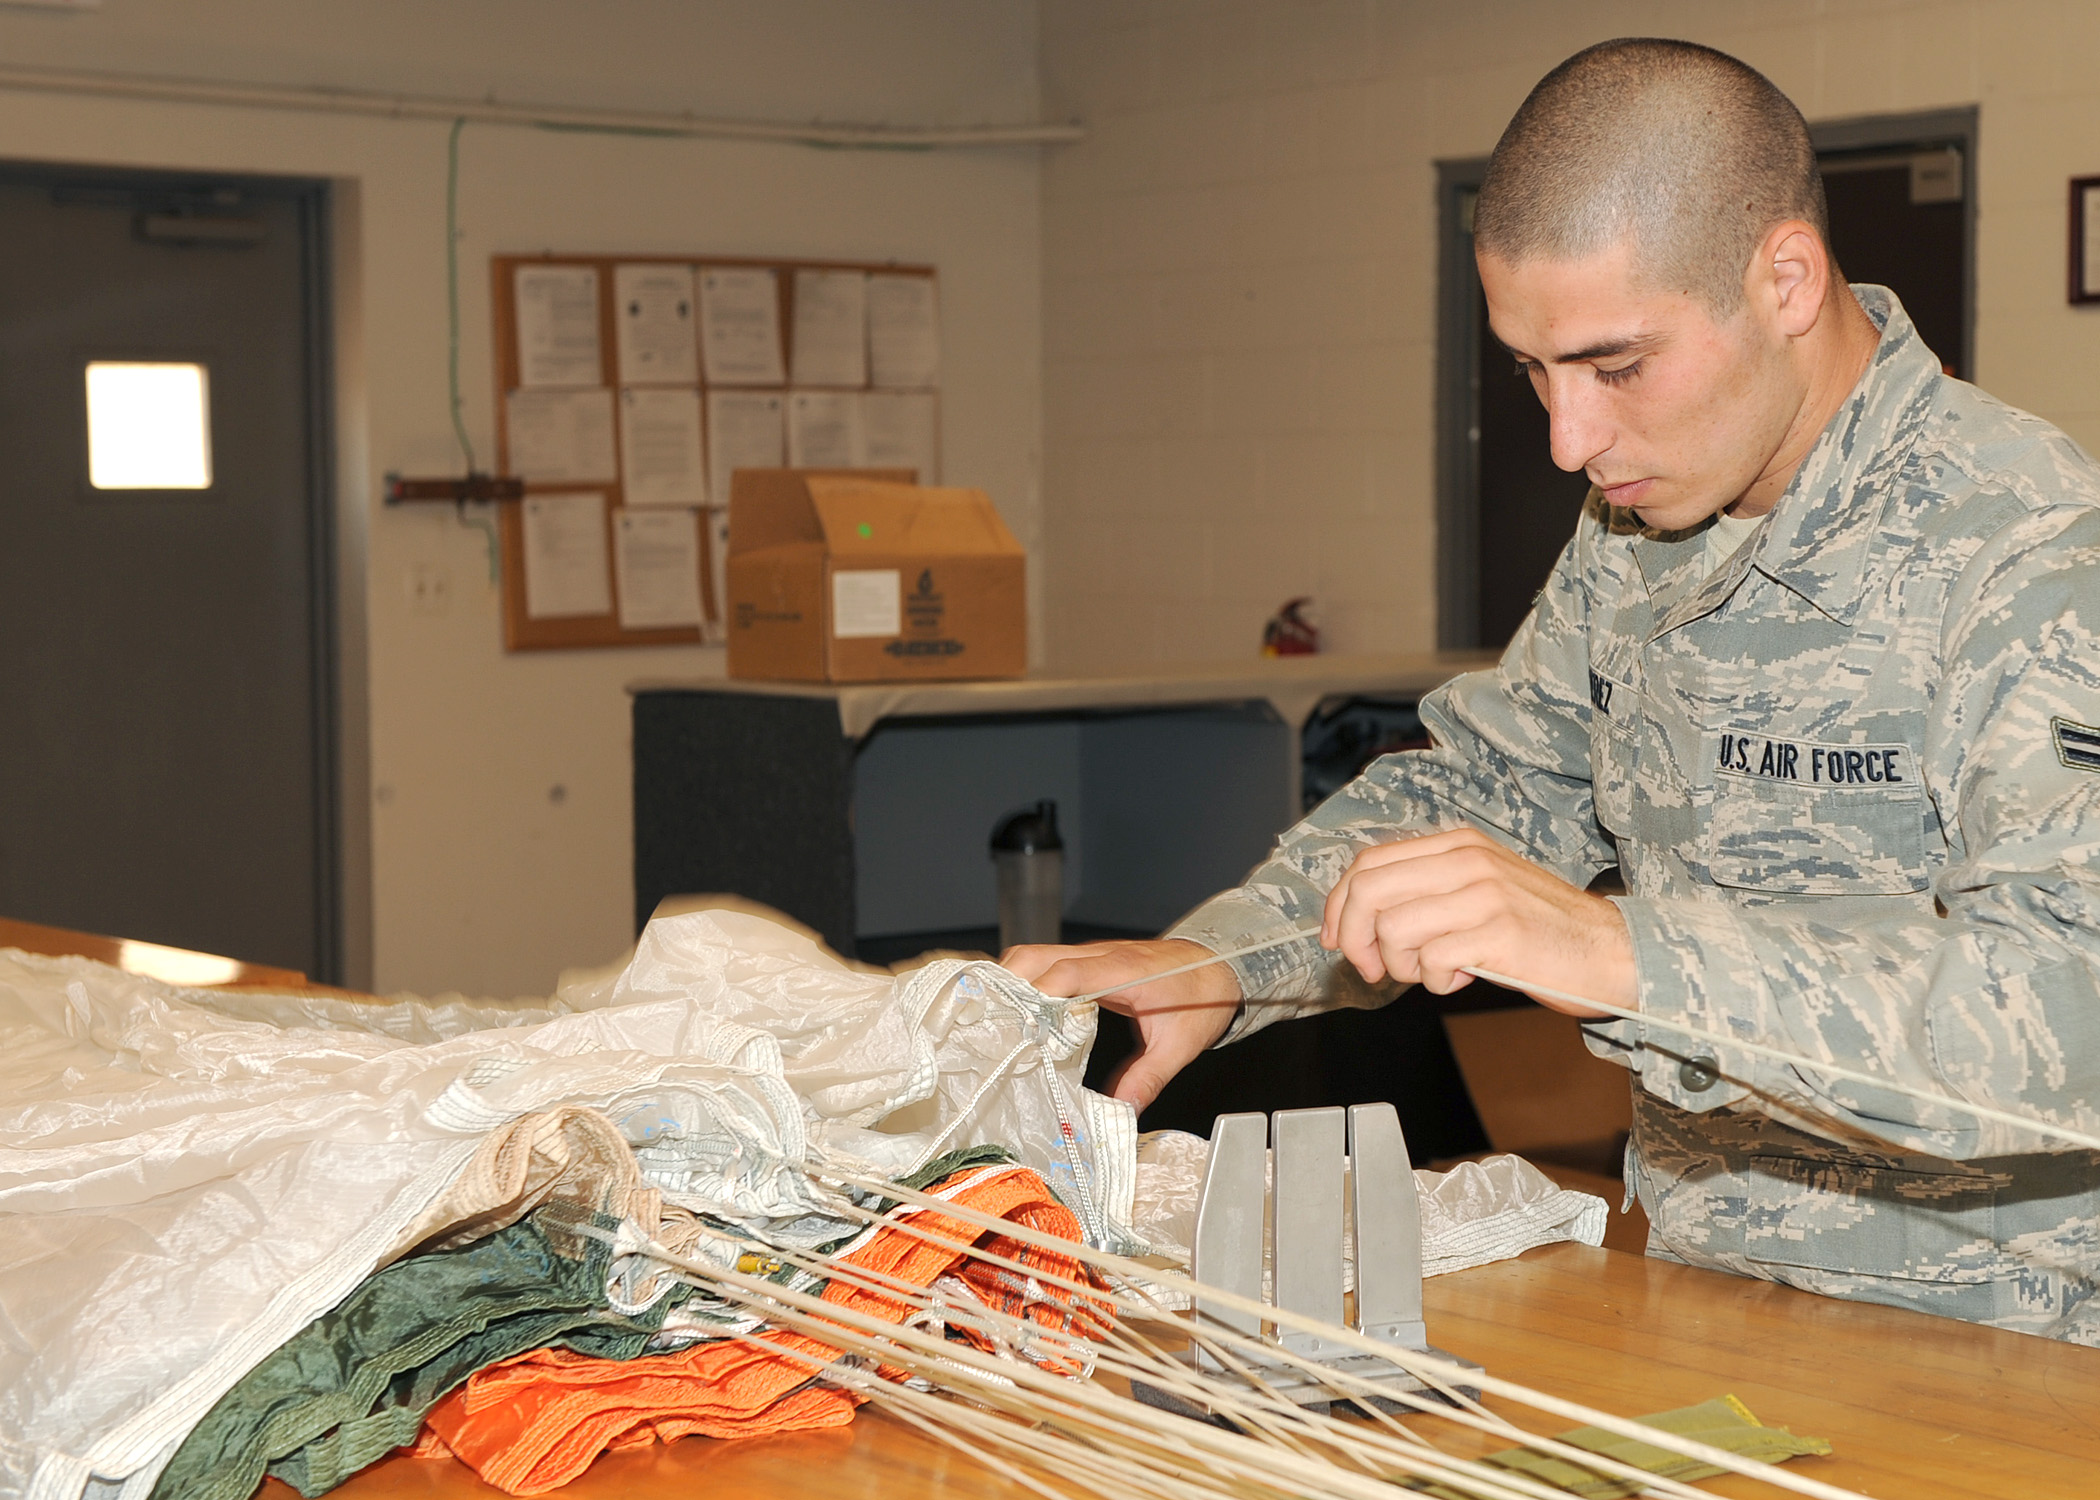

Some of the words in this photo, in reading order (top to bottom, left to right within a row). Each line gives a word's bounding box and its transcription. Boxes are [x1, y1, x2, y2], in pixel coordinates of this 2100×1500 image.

[1720, 734, 1751, 773] U.S.
[1760, 741, 1799, 780] AIR
[1812, 748, 1903, 783] FORCE
